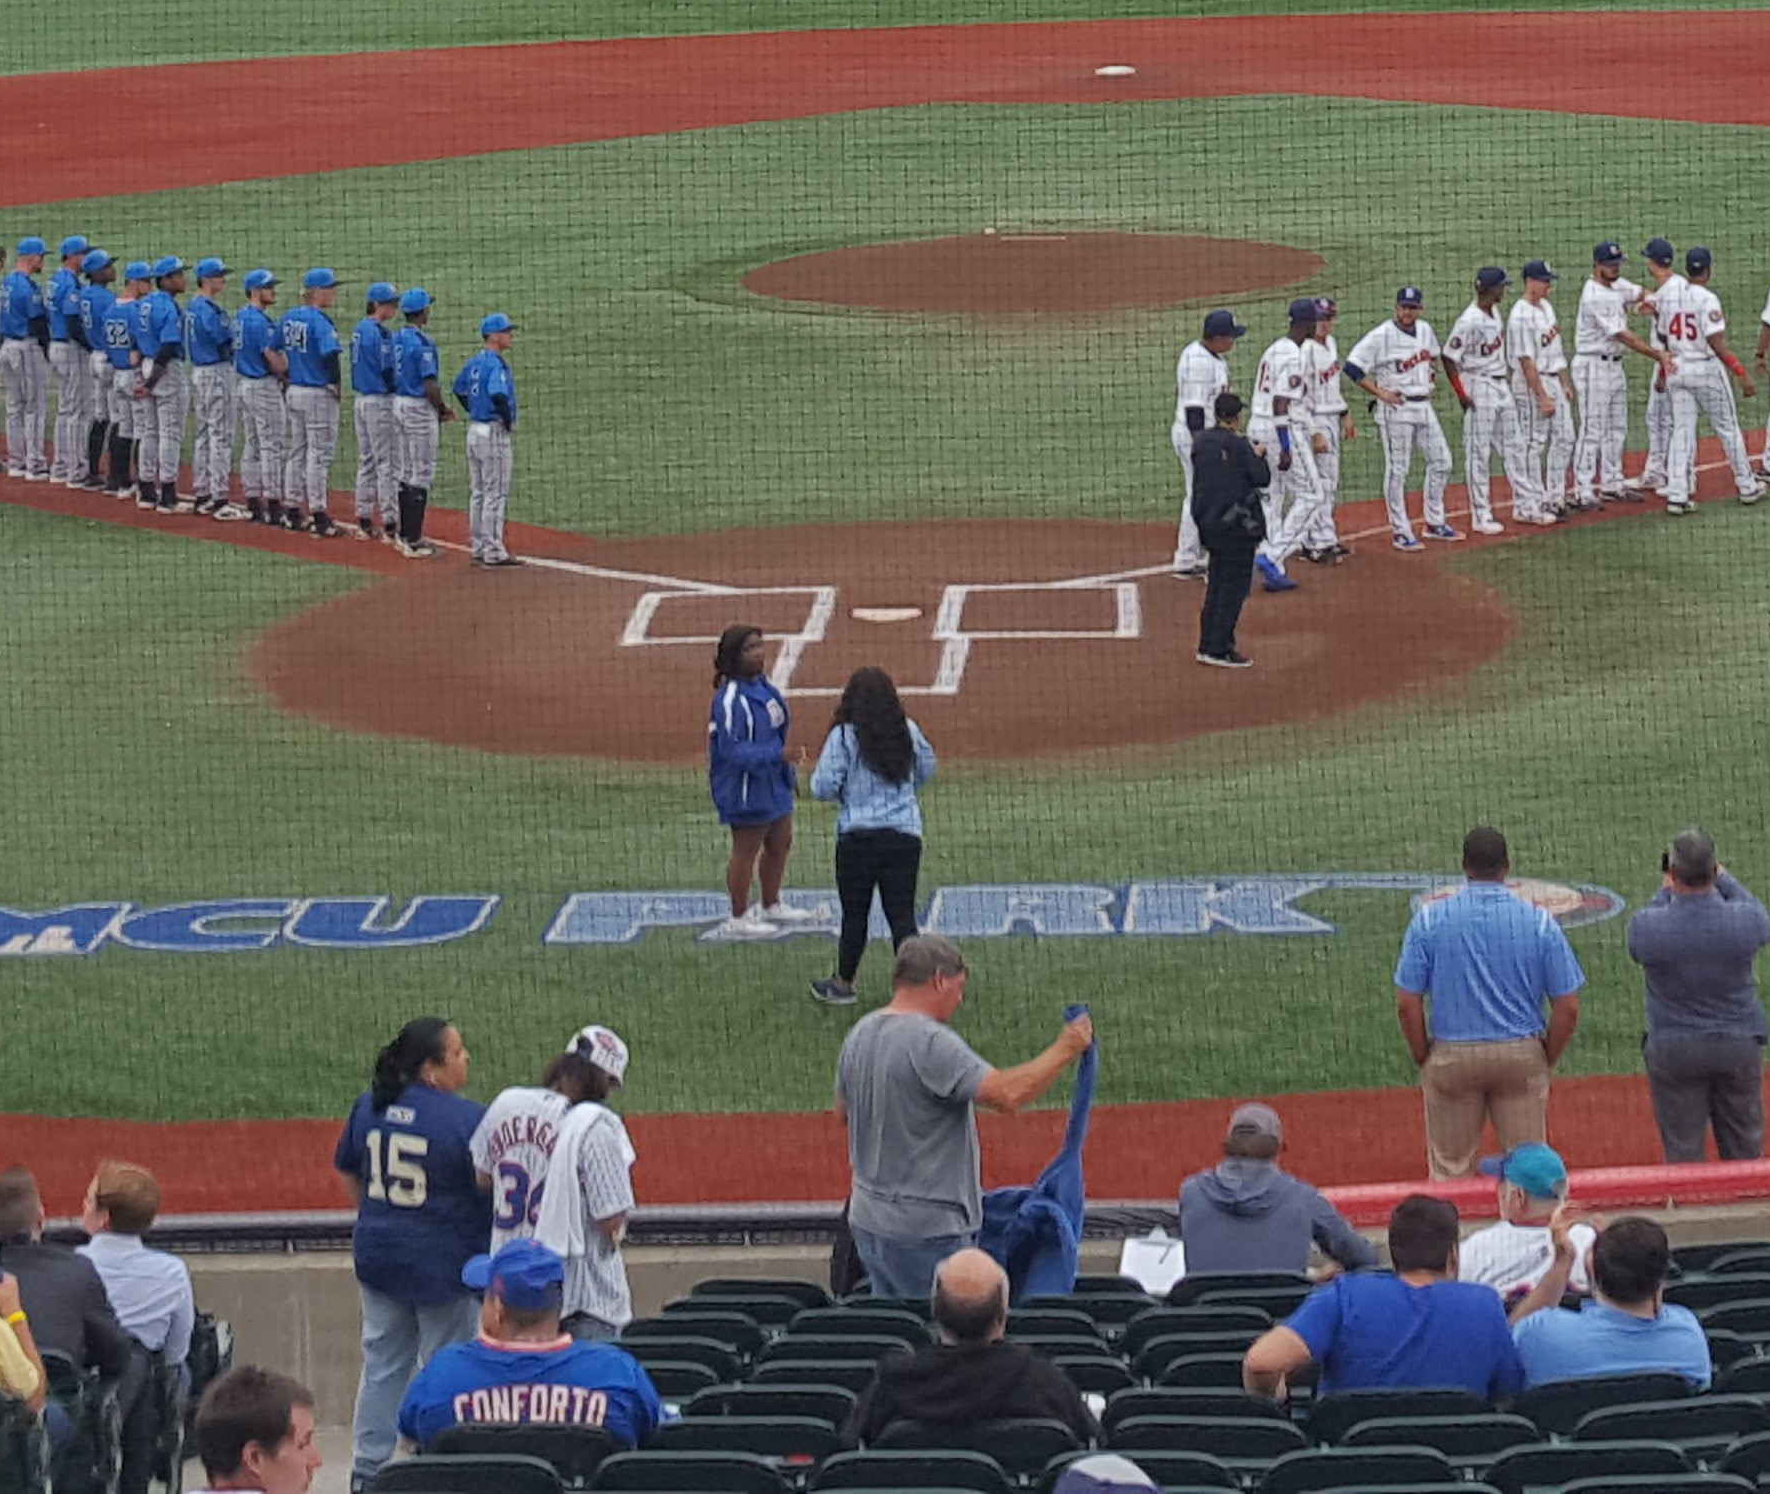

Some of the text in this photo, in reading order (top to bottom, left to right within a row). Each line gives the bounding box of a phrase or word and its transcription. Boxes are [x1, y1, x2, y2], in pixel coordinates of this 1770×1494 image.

[105, 318, 129, 349] 32
[283, 322, 309, 354] 34
[1669, 313, 1698, 342] 45
[542, 877, 1339, 944] PARK
[366, 1128, 428, 1208] 15
[453, 1383, 609, 1427] CONFORTO
